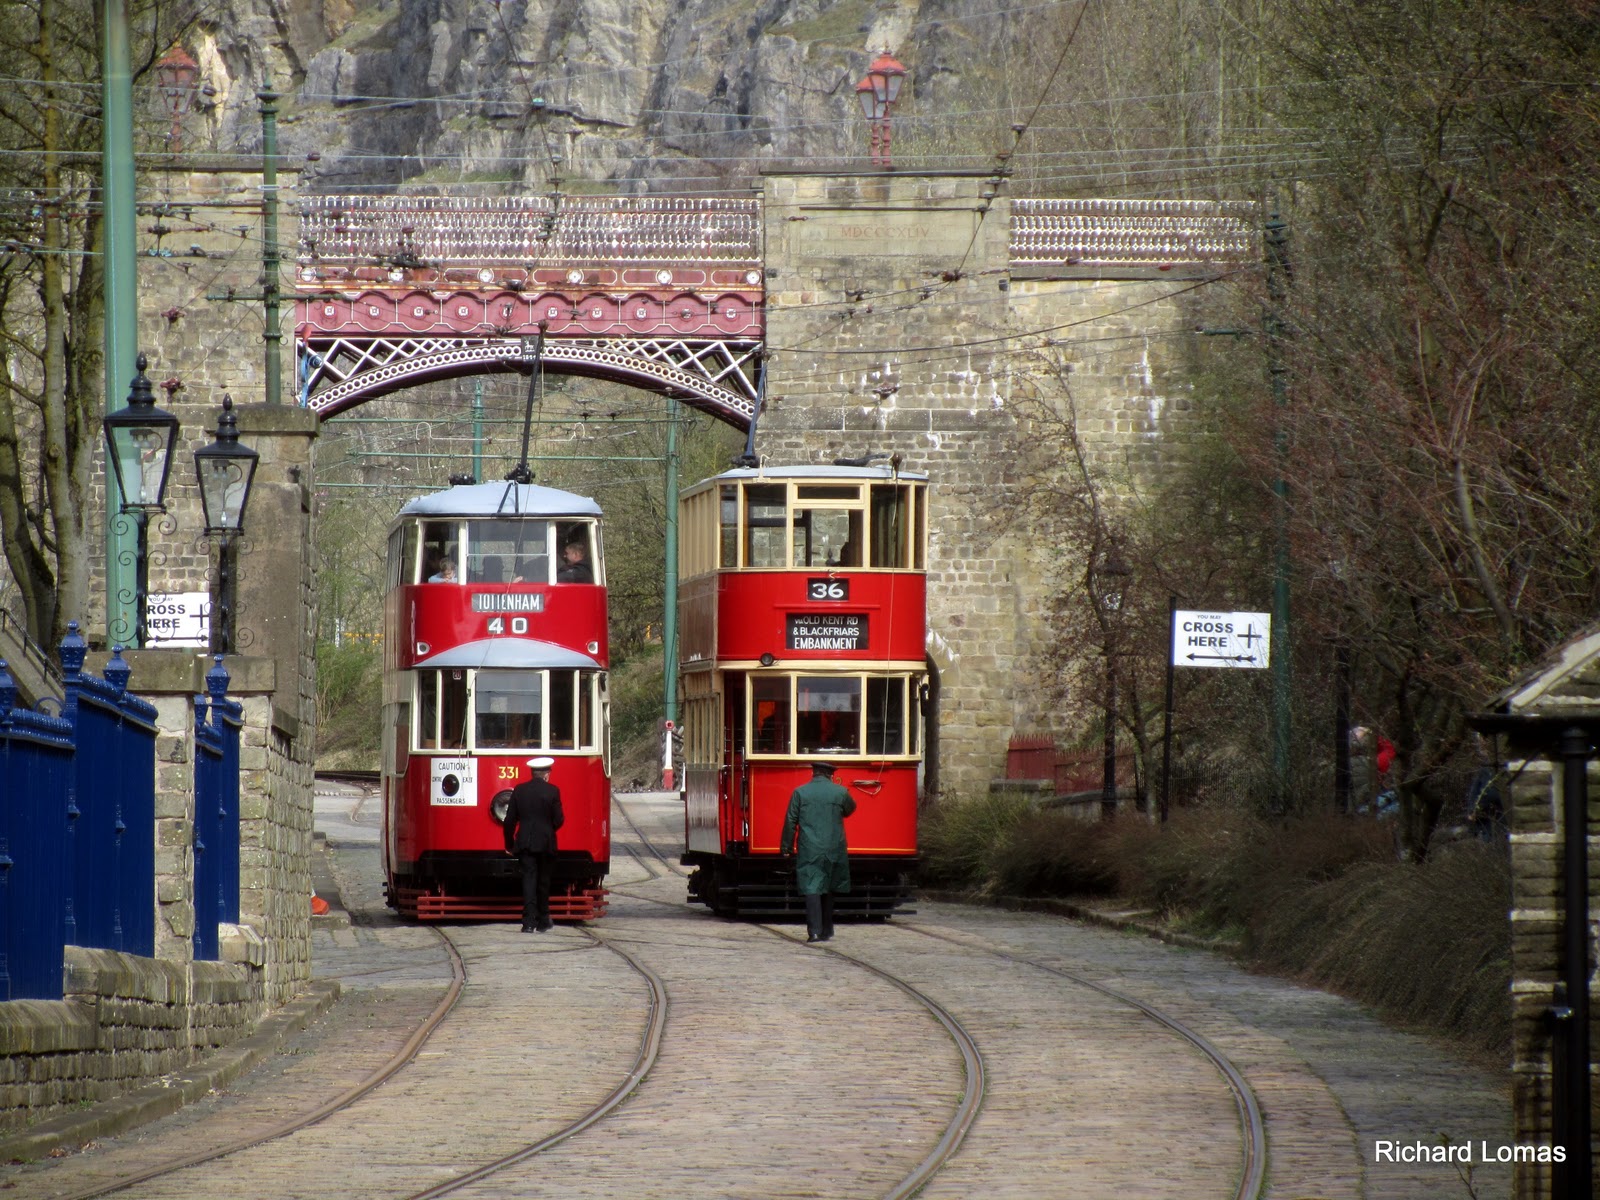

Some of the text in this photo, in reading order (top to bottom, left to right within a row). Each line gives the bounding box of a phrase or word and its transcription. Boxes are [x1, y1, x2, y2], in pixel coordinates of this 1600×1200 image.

[841, 226, 929, 238] MDCCCXLIV
[812, 582, 844, 599] 36
[478, 593, 540, 610] TOTTENHAM
[147, 604, 186, 615] ROSS
[803, 615, 820, 625] OLD
[822, 615, 845, 625] KENT
[846, 616, 859, 625] RD
[800, 626, 860, 636] BLACKFRIARS
[1183, 621, 1234, 634] CROSS
[794, 637, 858, 650] EMBANKMENT
[1188, 636, 1228, 648] HERE
[438, 762, 466, 771] CAUTION
[498, 766, 519, 779] 331
